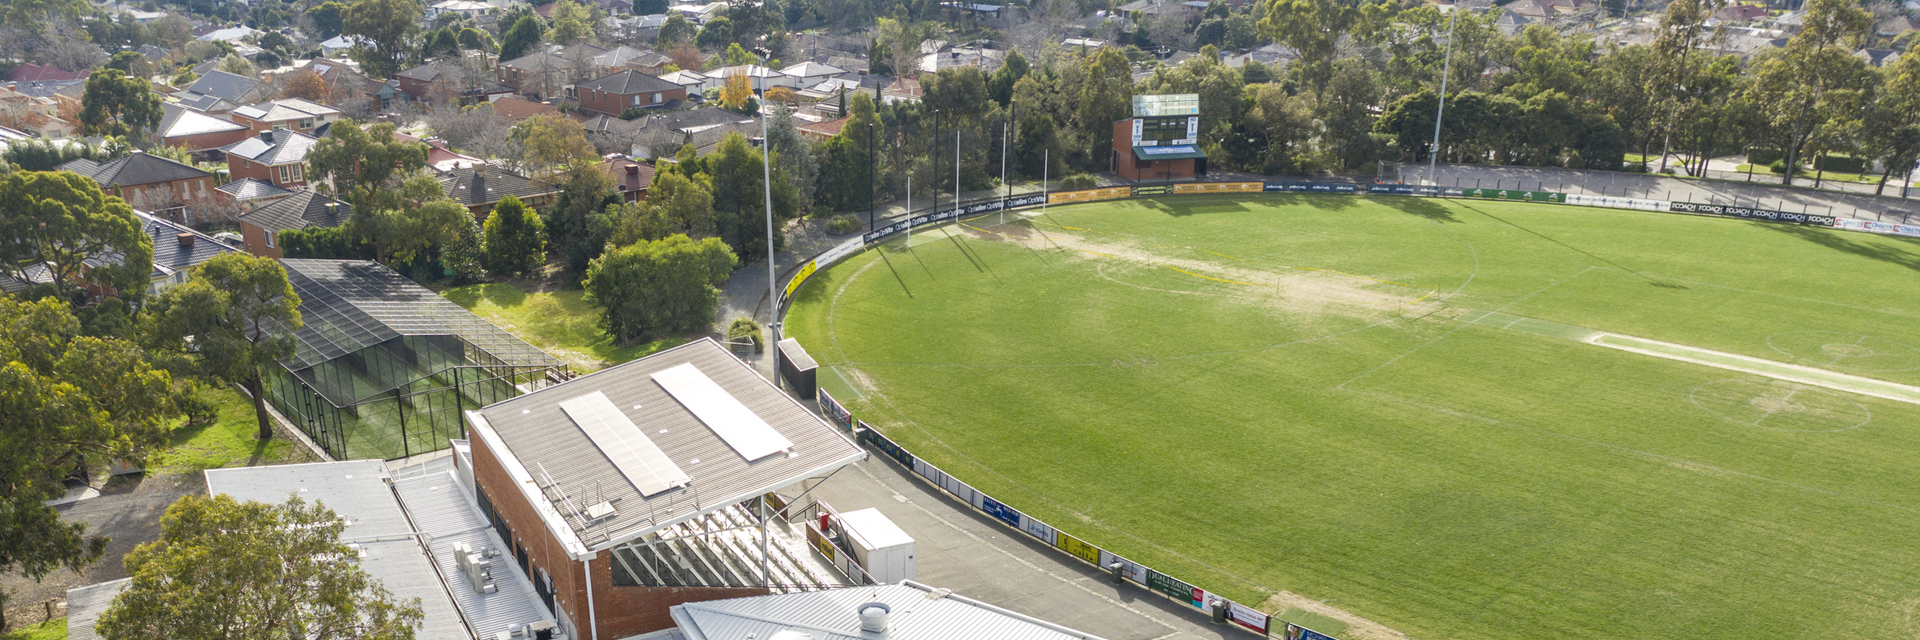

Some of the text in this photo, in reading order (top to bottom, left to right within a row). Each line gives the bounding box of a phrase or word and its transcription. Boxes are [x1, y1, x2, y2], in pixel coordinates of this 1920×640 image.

[1675, 202, 1696, 210] COACH
[1702, 205, 1723, 213] COACH
[1729, 207, 1750, 215] COACH
[1756, 210, 1777, 218] COACH
[1783, 212, 1805, 221] COACH
[1811, 215, 1833, 224] COACH
